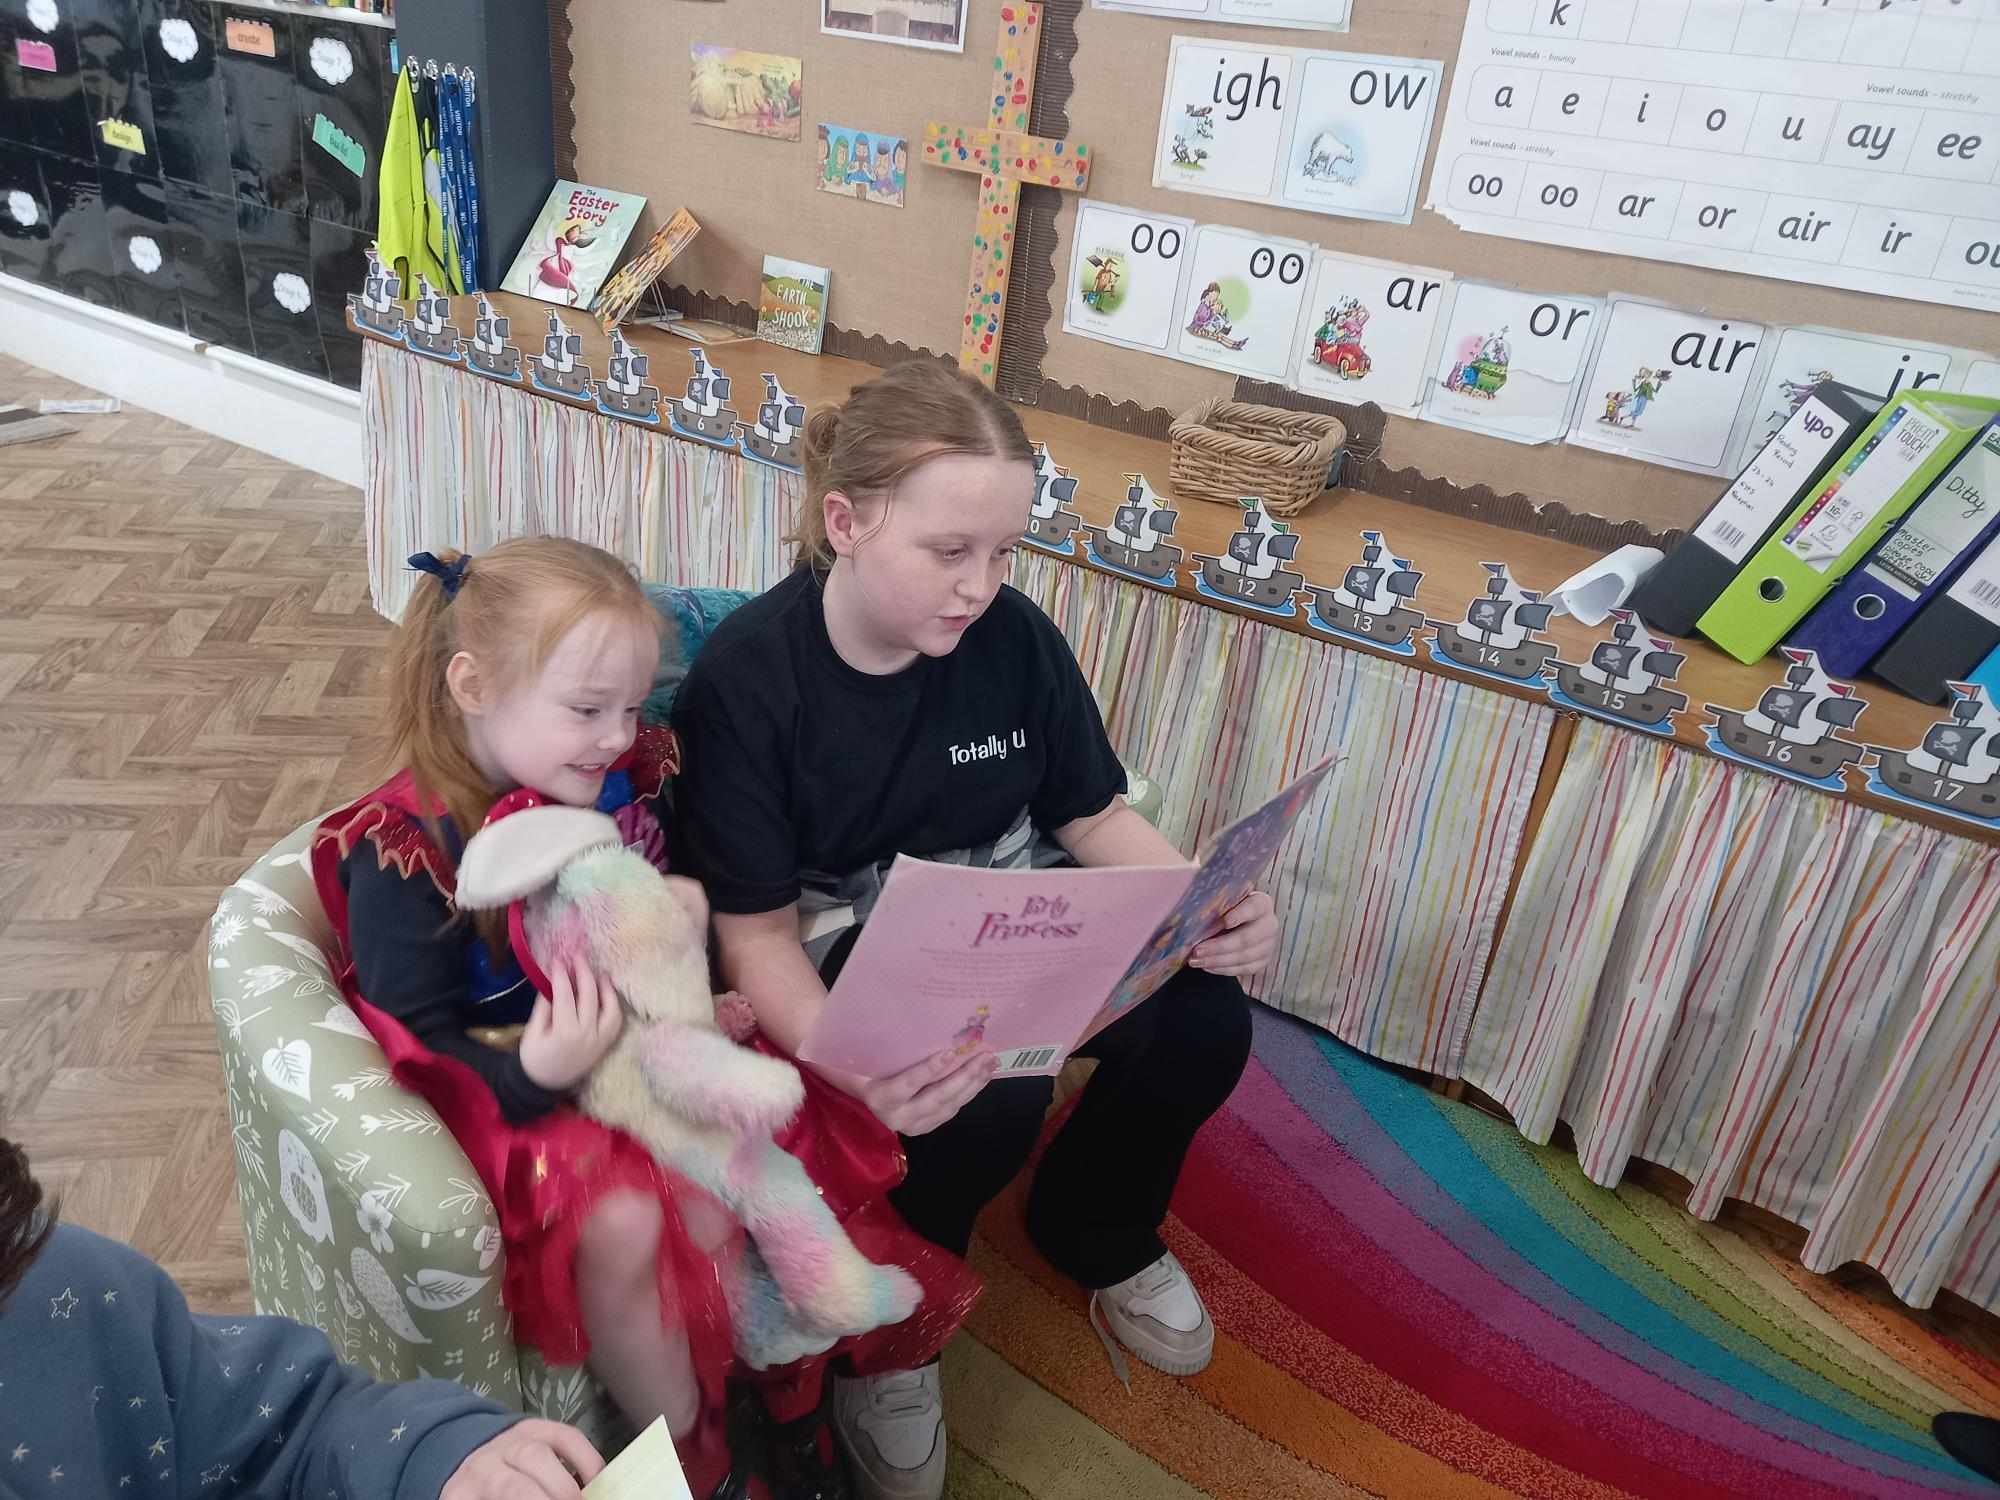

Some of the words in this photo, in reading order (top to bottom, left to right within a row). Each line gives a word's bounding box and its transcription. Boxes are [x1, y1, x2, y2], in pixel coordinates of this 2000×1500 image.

[1550, 0, 1571, 26] k
[1491, 47, 1514, 57] Vowel
[1514, 50, 1540, 60] sounds
[1212, 56, 1283, 122] igh
[1349, 69, 1428, 111] ow
[1866, 83, 1895, 95] Vowel
[1896, 86, 1929, 98] sounds
[454, 110, 464, 136] VISITOR
[1494, 86, 1514, 109] a
[1561, 92, 1581, 115] e
[1637, 93, 1648, 123] i
[1705, 109, 1727, 132] o
[1781, 115, 1806, 141] u
[1847, 122, 1896, 161] ay
[1936, 131, 1982, 160] ee
[1469, 137, 1491, 149] Vowel
[1492, 141, 1517, 152] sounds
[569, 190, 620, 212] Easter
[565, 206, 607, 227] Story
[1468, 173, 1504, 198] oo
[1540, 183, 1578, 208] oo
[1617, 193, 1655, 219] ar
[1698, 204, 1737, 229] or
[1777, 211, 1831, 244] air
[1879, 223, 1913, 254] ir
[1131, 223, 1181, 259] oo
[1249, 247, 1305, 285] oo
[777, 283, 807, 305] EARTH
[1386, 277, 1441, 312] ar
[772, 307, 809, 328] SHOOK
[1529, 302, 1591, 341] or
[427, 334, 433, 348] 2
[1671, 324, 1756, 374] air
[487, 355, 495, 368] 3
[555, 374, 563, 387] 4
[622, 397, 629, 409] 5
[697, 417, 705, 431] 6
[770, 443, 778, 457] 7
[1896, 429, 1926, 453] TOUCH
[1946, 476, 1985, 518] Ditty
[1894, 538, 1923, 557] copies
[1900, 528, 1935, 552] master
[1123, 550, 1139, 567] 11
[1236, 578, 1257, 597] 12
[1352, 612, 1374, 632] 13
[1477, 647, 1501, 667] 14
[1600, 690, 1626, 710] 15
[949, 735, 1007, 765] Totally
[1012, 728, 1026, 748] U
[1766, 740, 1793, 762] 16
[1931, 779, 1965, 801] 17
[970, 911, 1084, 948] Princess
